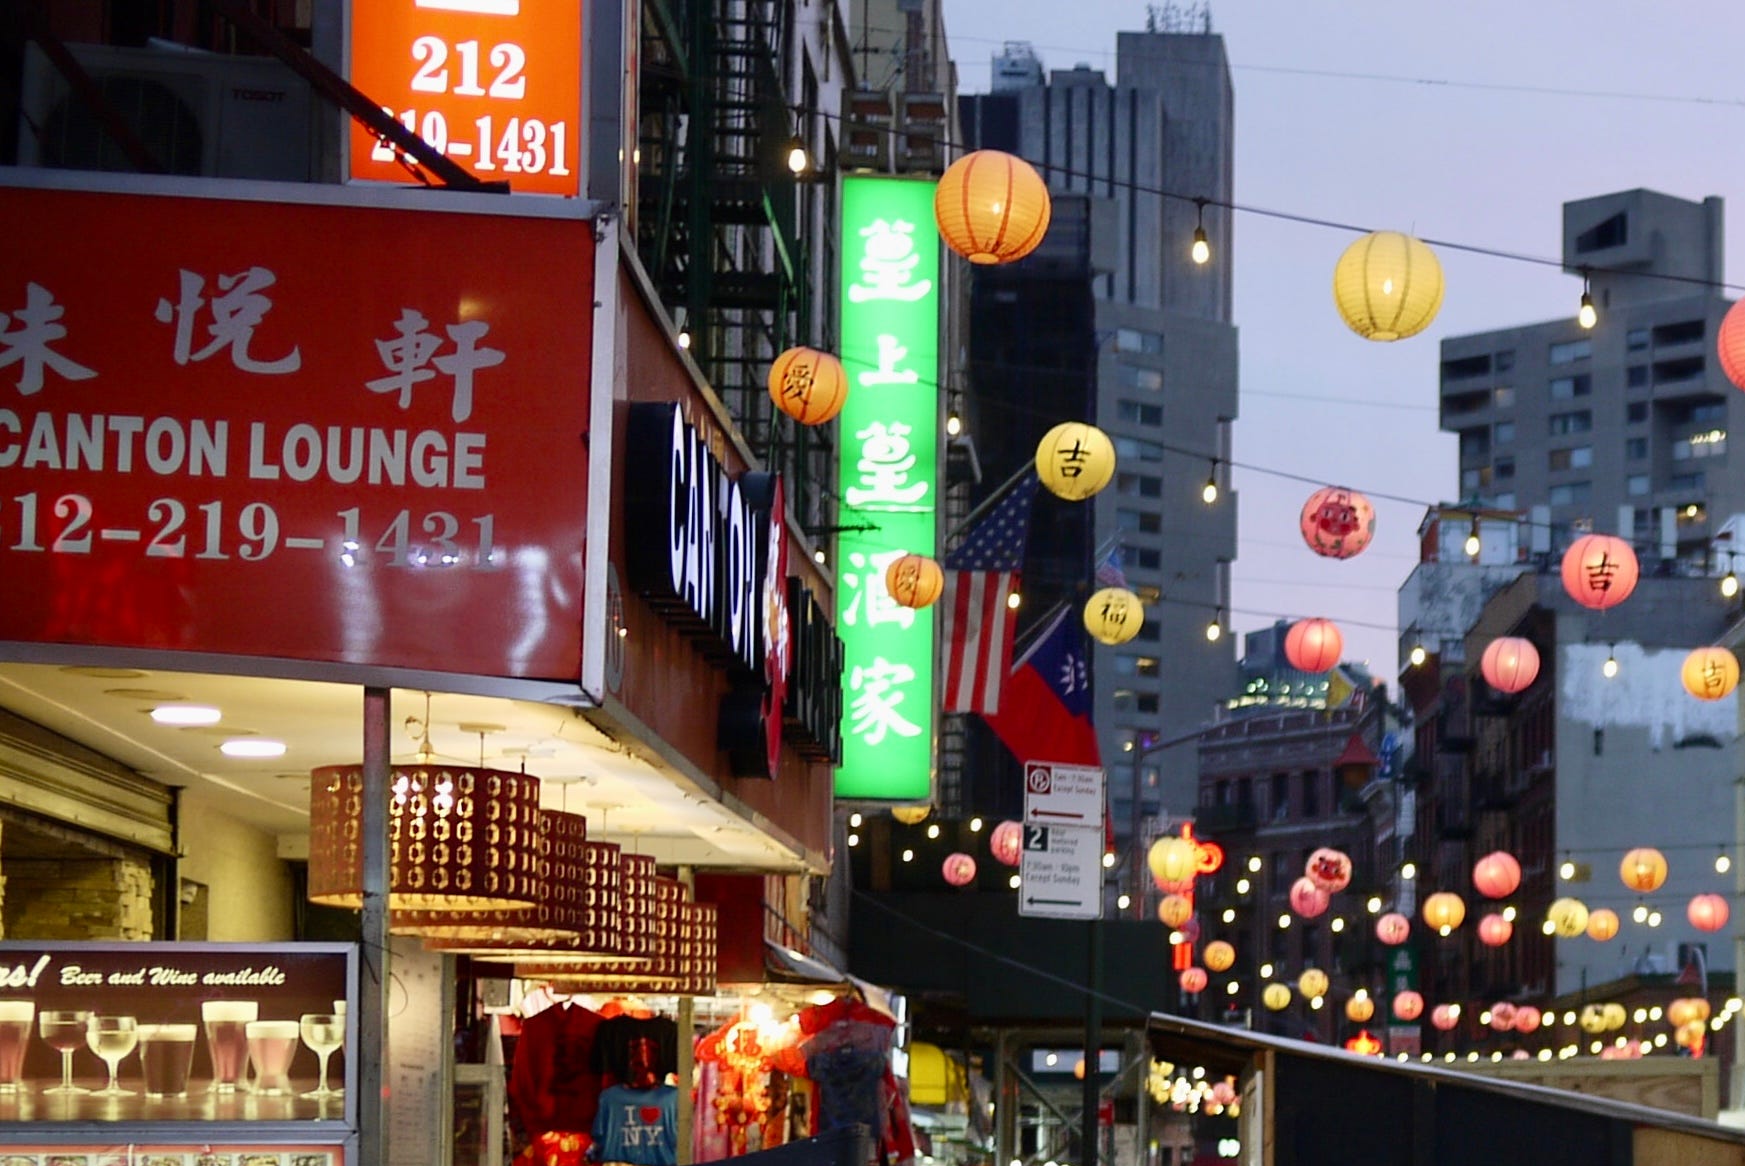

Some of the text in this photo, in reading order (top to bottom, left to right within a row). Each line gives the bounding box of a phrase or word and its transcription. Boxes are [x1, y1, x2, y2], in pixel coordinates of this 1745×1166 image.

[411, 36, 526, 99] 212
[0, 409, 486, 489] CANTON LOUNGE
[1058, 438, 1092, 479] 吉
[0, 492, 501, 570] 12-219-1431
[1586, 551, 1620, 592] 吉
[1029, 826, 1043, 850] 2
[60, 965, 103, 986] Beer
[108, 967, 145, 986] and
[149, 966, 198, 986] Wine
[202, 965, 286, 986] available
[622, 1125, 664, 1147] NY
[624, 1105, 637, 1126] I
